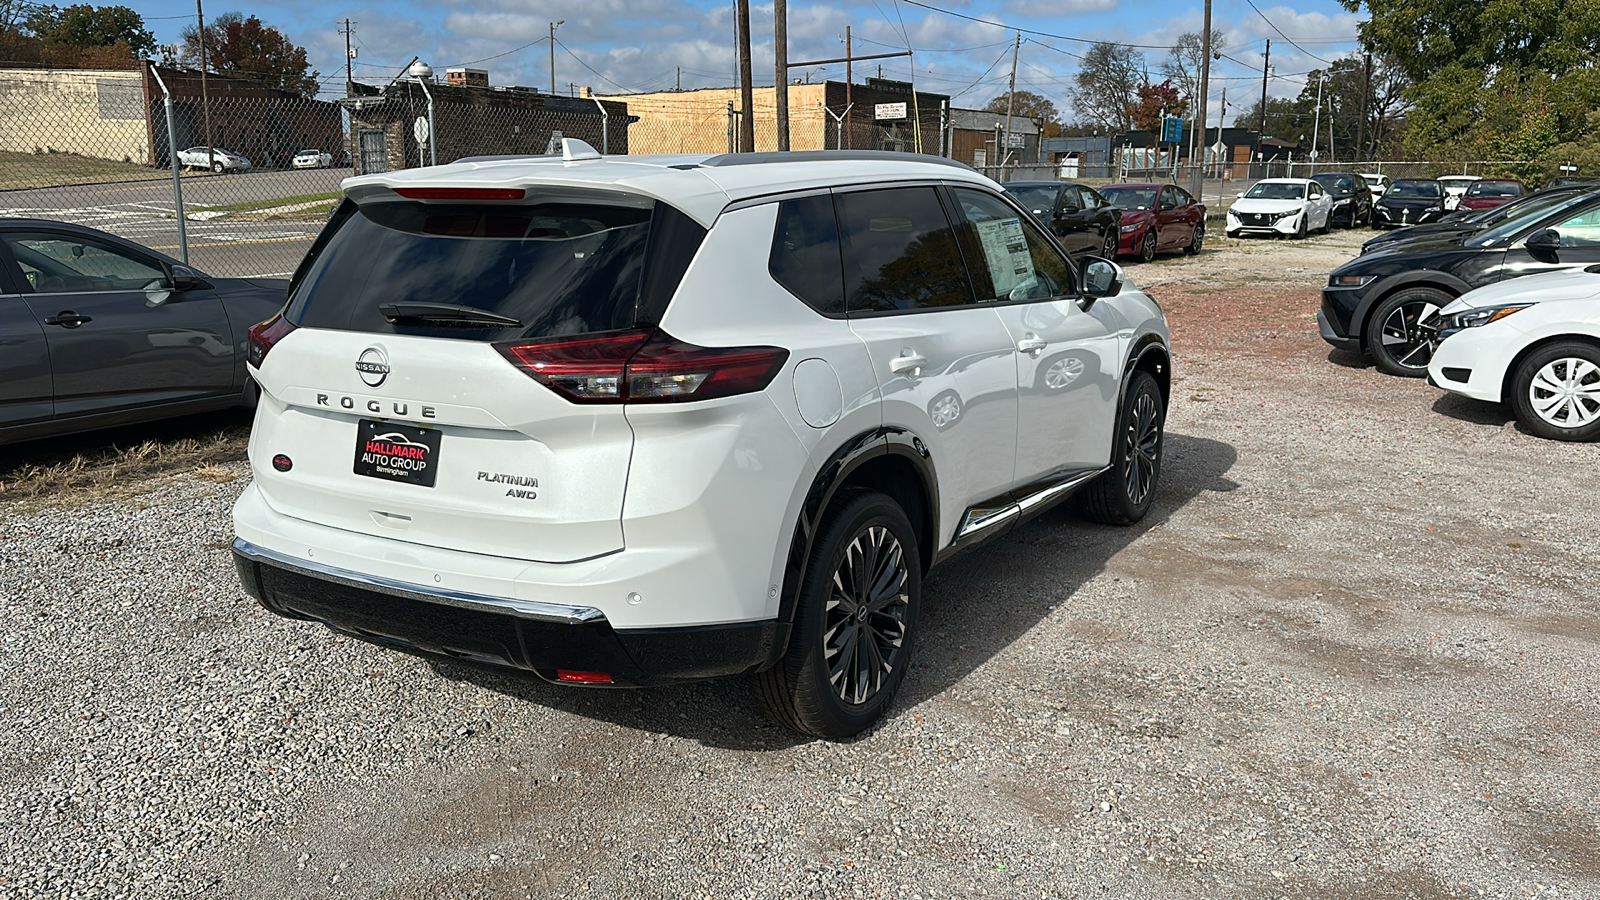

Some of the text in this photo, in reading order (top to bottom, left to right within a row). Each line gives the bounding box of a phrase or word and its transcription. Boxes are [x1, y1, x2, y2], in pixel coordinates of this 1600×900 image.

[355, 362, 389, 373] NISSAN
[317, 393, 436, 418] ROGUE
[366, 441, 425, 460] HALLMARK
[361, 451, 427, 472] AUTO GROUP
[376, 465, 409, 477] Birmingham
[477, 471, 539, 488] PLATINUM
[505, 488, 537, 500] AWD
